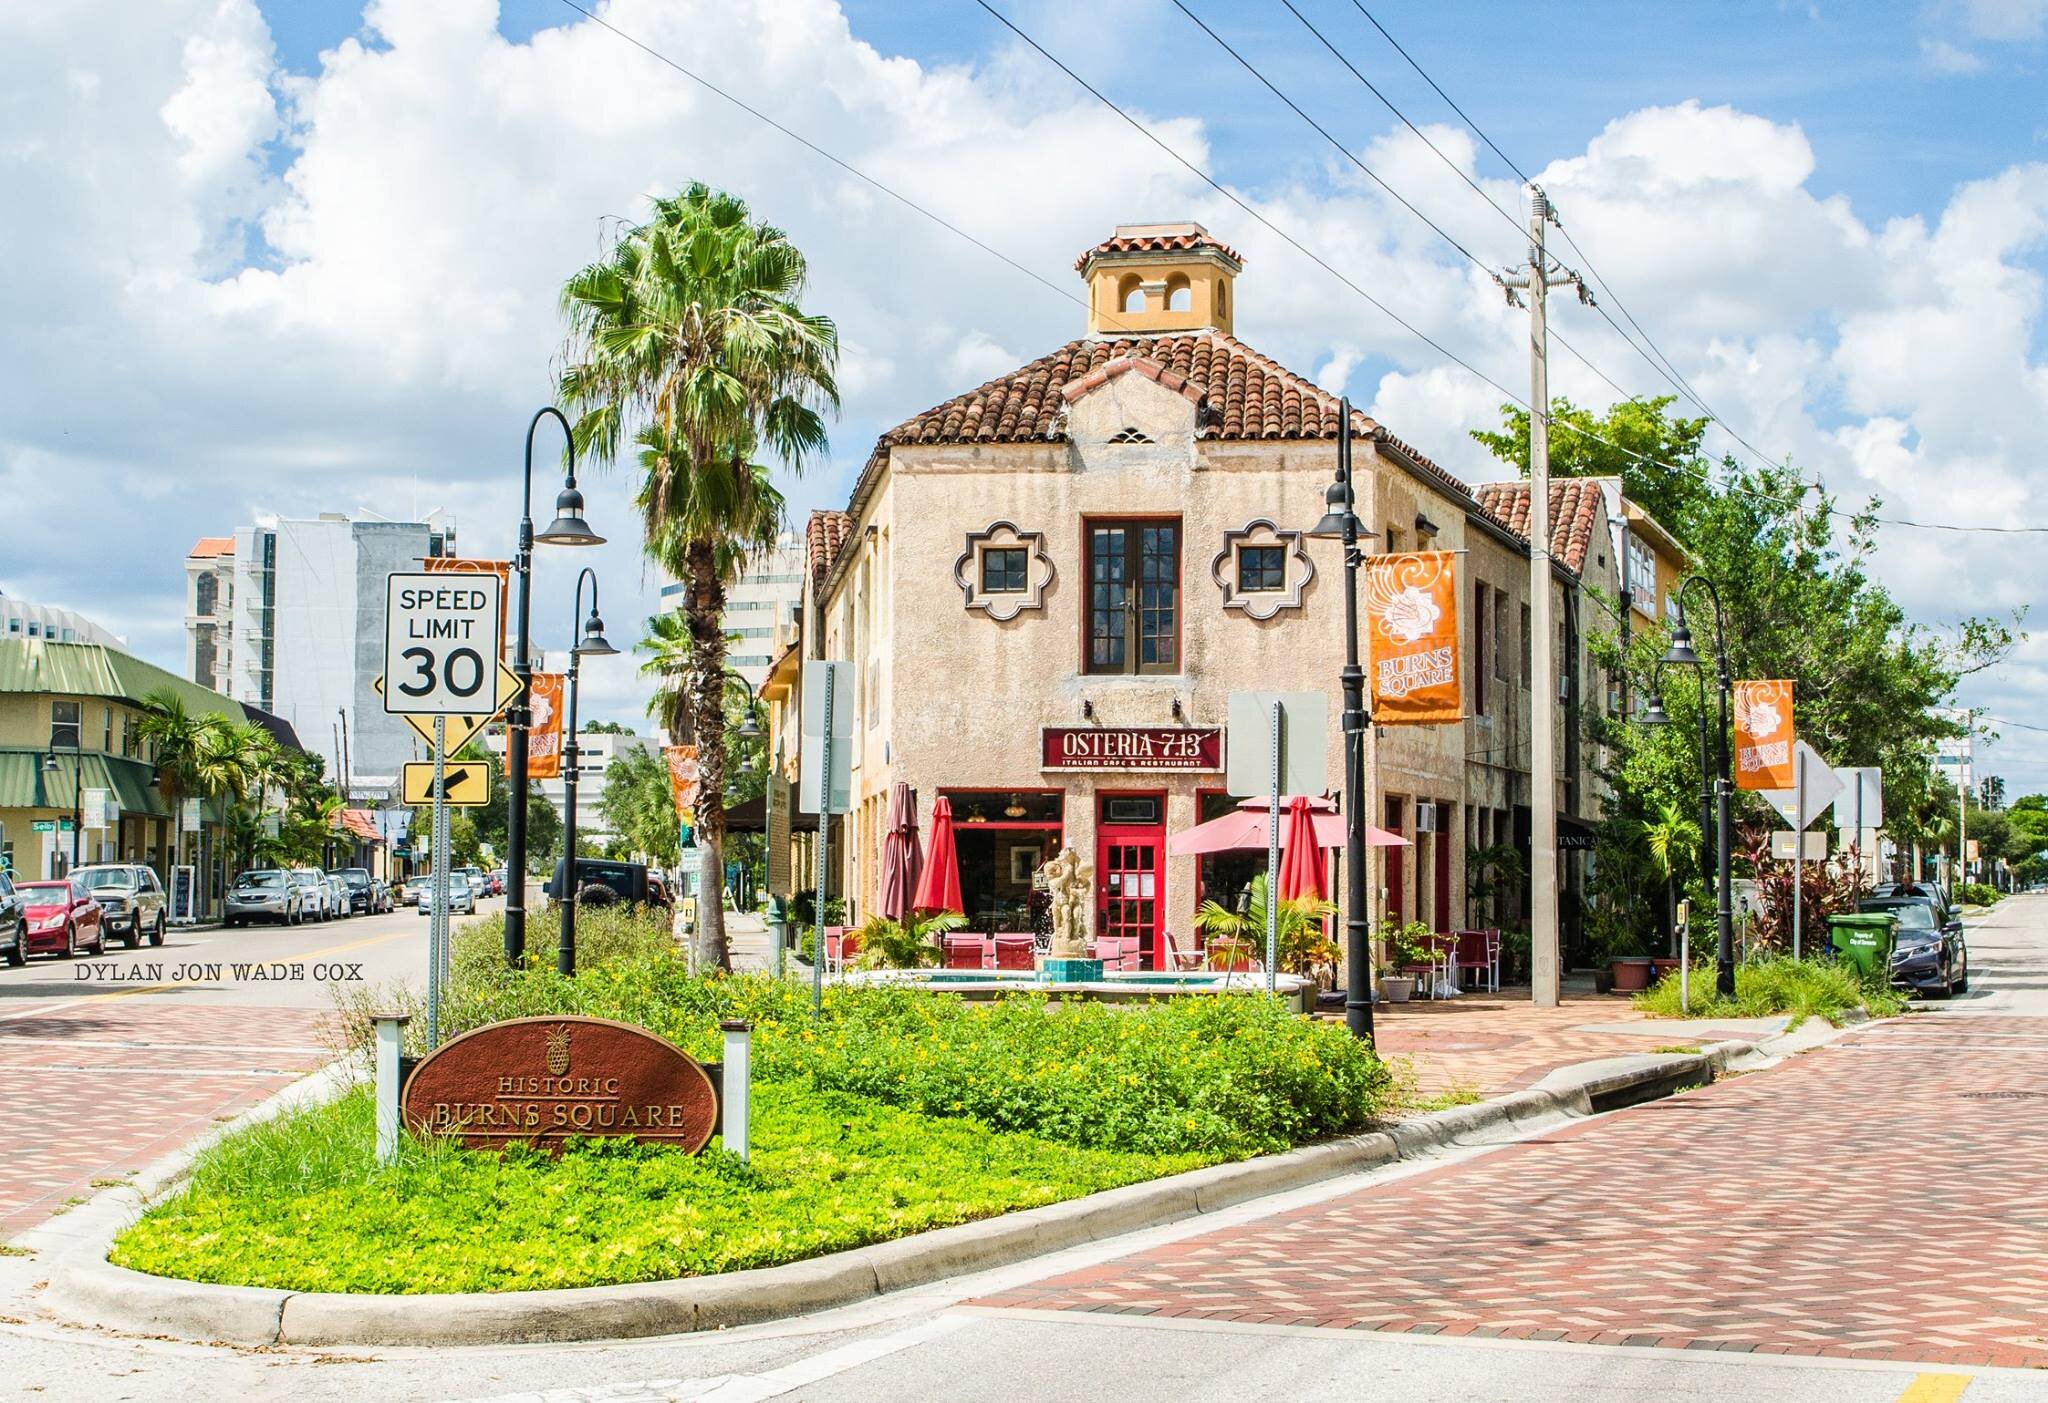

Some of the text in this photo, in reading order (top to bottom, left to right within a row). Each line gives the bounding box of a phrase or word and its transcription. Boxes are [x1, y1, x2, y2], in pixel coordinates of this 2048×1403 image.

[400, 589, 487, 610] SPEED
[409, 618, 476, 639] LIMIT
[398, 647, 485, 698] 30
[1378, 647, 1453, 679] BURNS
[1378, 667, 1454, 697] SQUARE
[1062, 733, 1201, 757] OSTERIA 7.13
[1739, 741, 1789, 761] BURNS
[498, 1077, 620, 1094] HISTORIC
[434, 1103, 685, 1131] BURNS SQUARE
